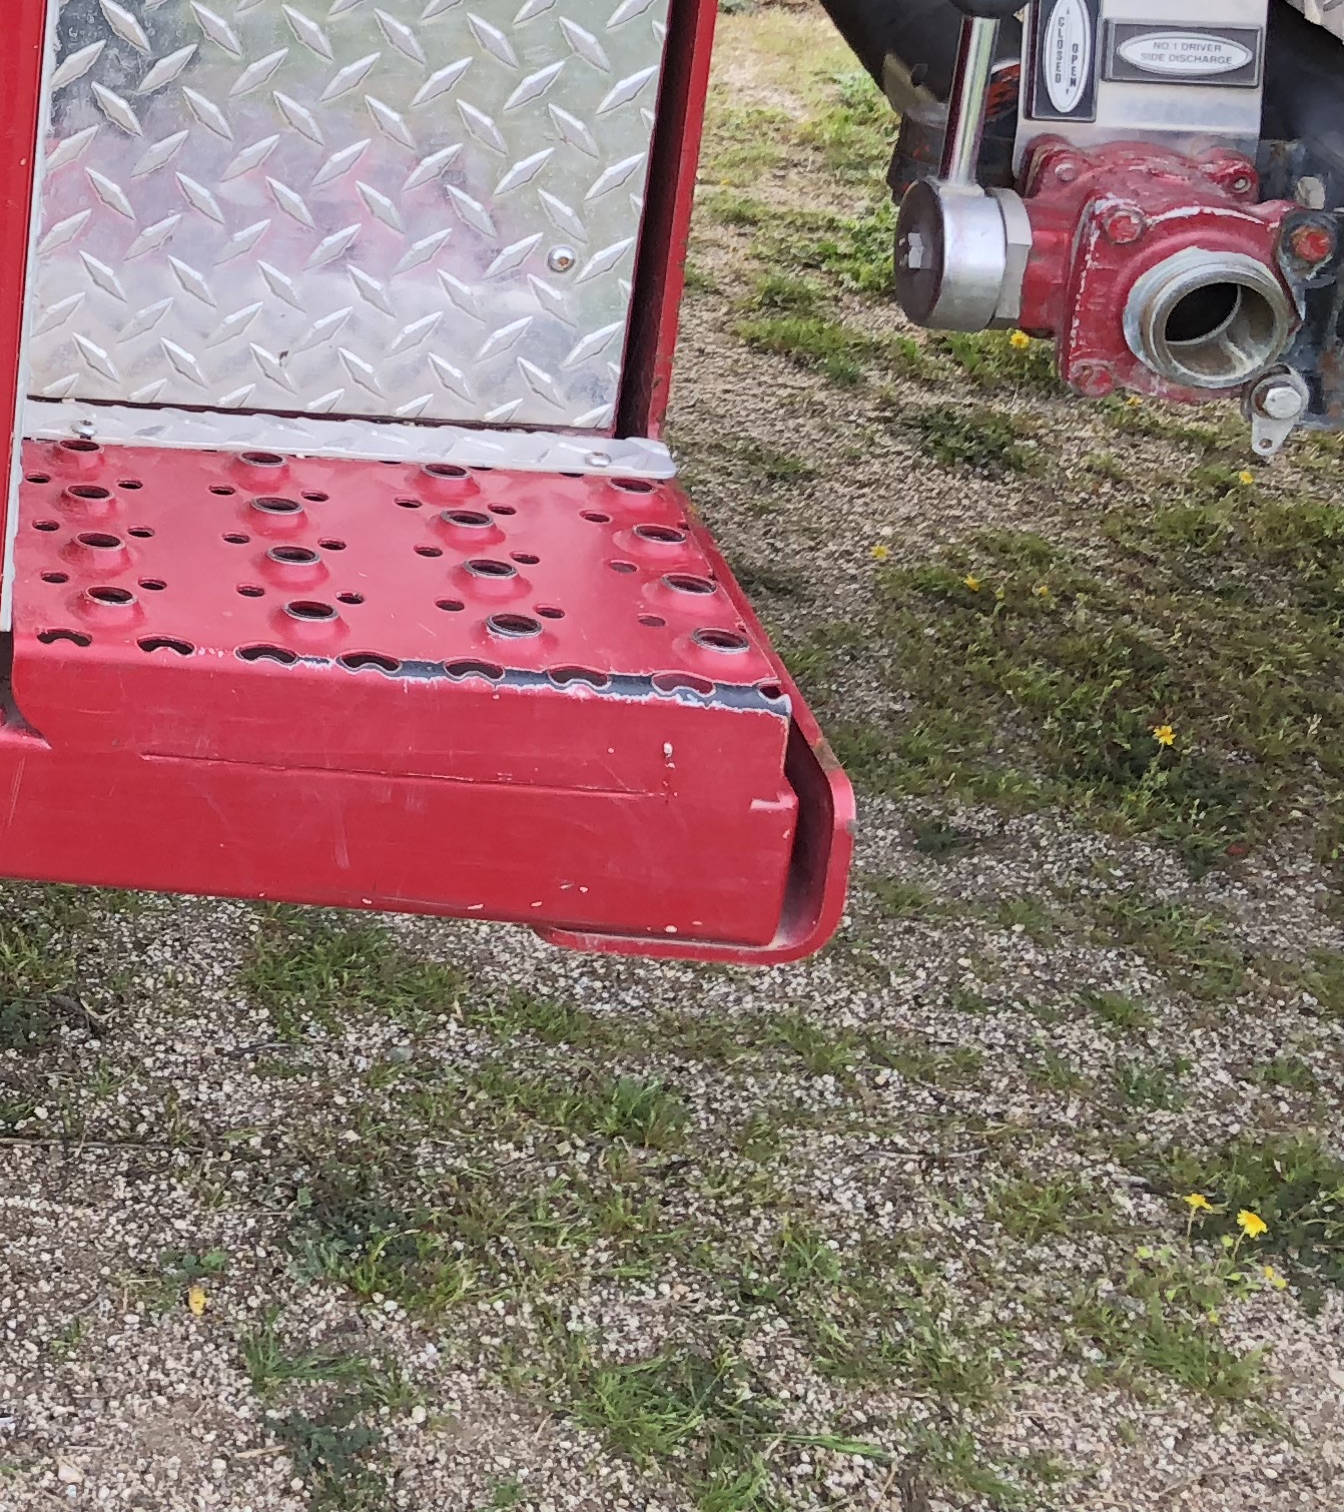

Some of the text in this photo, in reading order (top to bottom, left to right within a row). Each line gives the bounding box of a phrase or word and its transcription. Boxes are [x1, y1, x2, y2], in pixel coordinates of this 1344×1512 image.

[1054, 17, 1065, 83] CLOSED
[1140, 52, 1232, 65] SIDE DISCHARGE
[1183, 42, 1222, 52] DRIVER
[1070, 43, 1079, 87] OPEN
